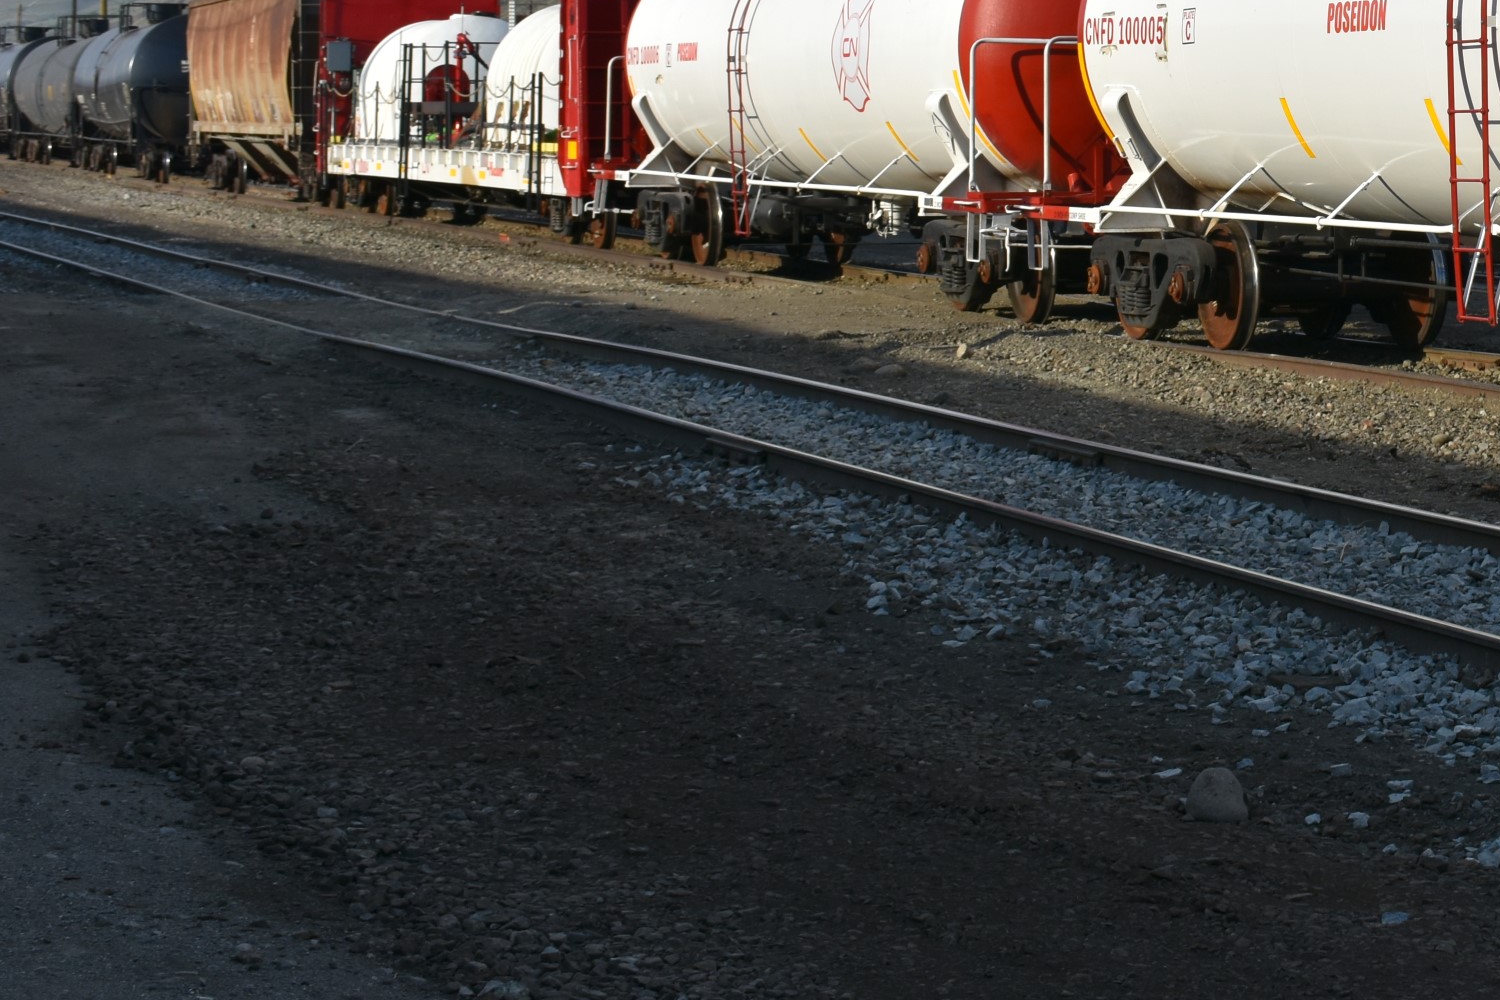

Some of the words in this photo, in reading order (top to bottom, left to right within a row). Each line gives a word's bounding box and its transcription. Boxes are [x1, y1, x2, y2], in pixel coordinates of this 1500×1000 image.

[1085, 17, 1114, 45] CNFD
[1118, 16, 1164, 45] 100005
[1185, 20, 1191, 41] C
[843, 37, 858, 57] CN
